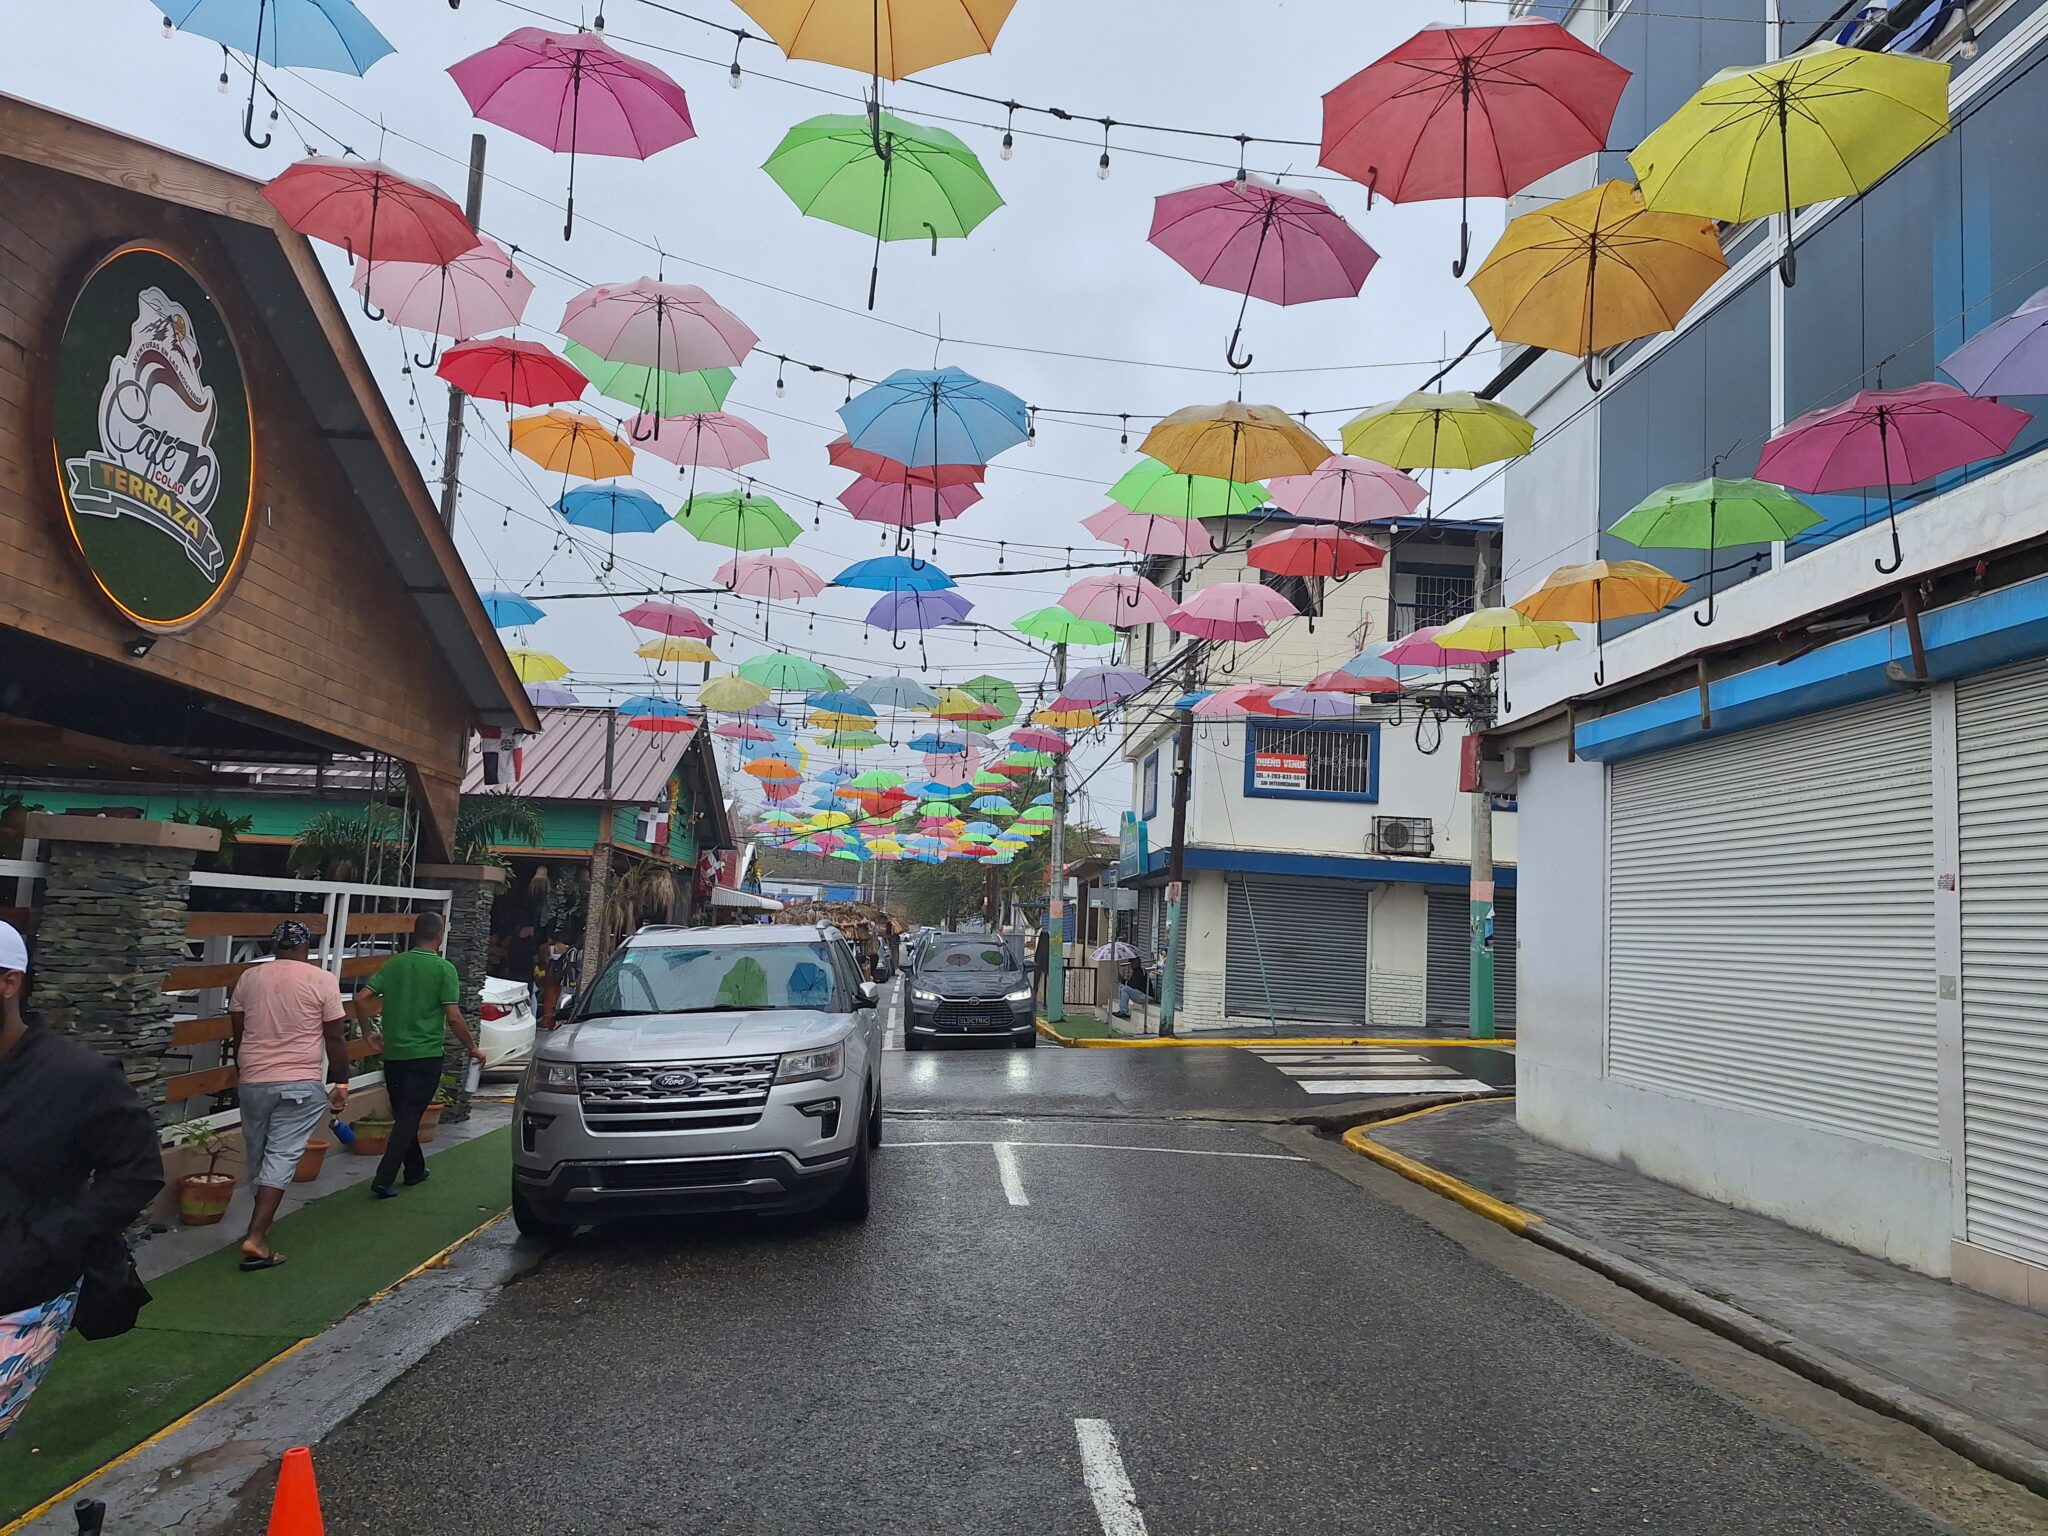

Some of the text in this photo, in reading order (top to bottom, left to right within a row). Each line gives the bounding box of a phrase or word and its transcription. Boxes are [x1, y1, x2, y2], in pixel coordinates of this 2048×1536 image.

[132, 341, 160, 368] AVENTURAS
[161, 347, 169, 358] EN
[169, 355, 179, 371] LAS
[105, 379, 181, 481] Café
[155, 470, 185, 496] COLAO
[101, 463, 199, 540] TERRAZA
[1256, 757, 1306, 769] DUEÑO VENDE
[661, 1075, 686, 1086] Ford
